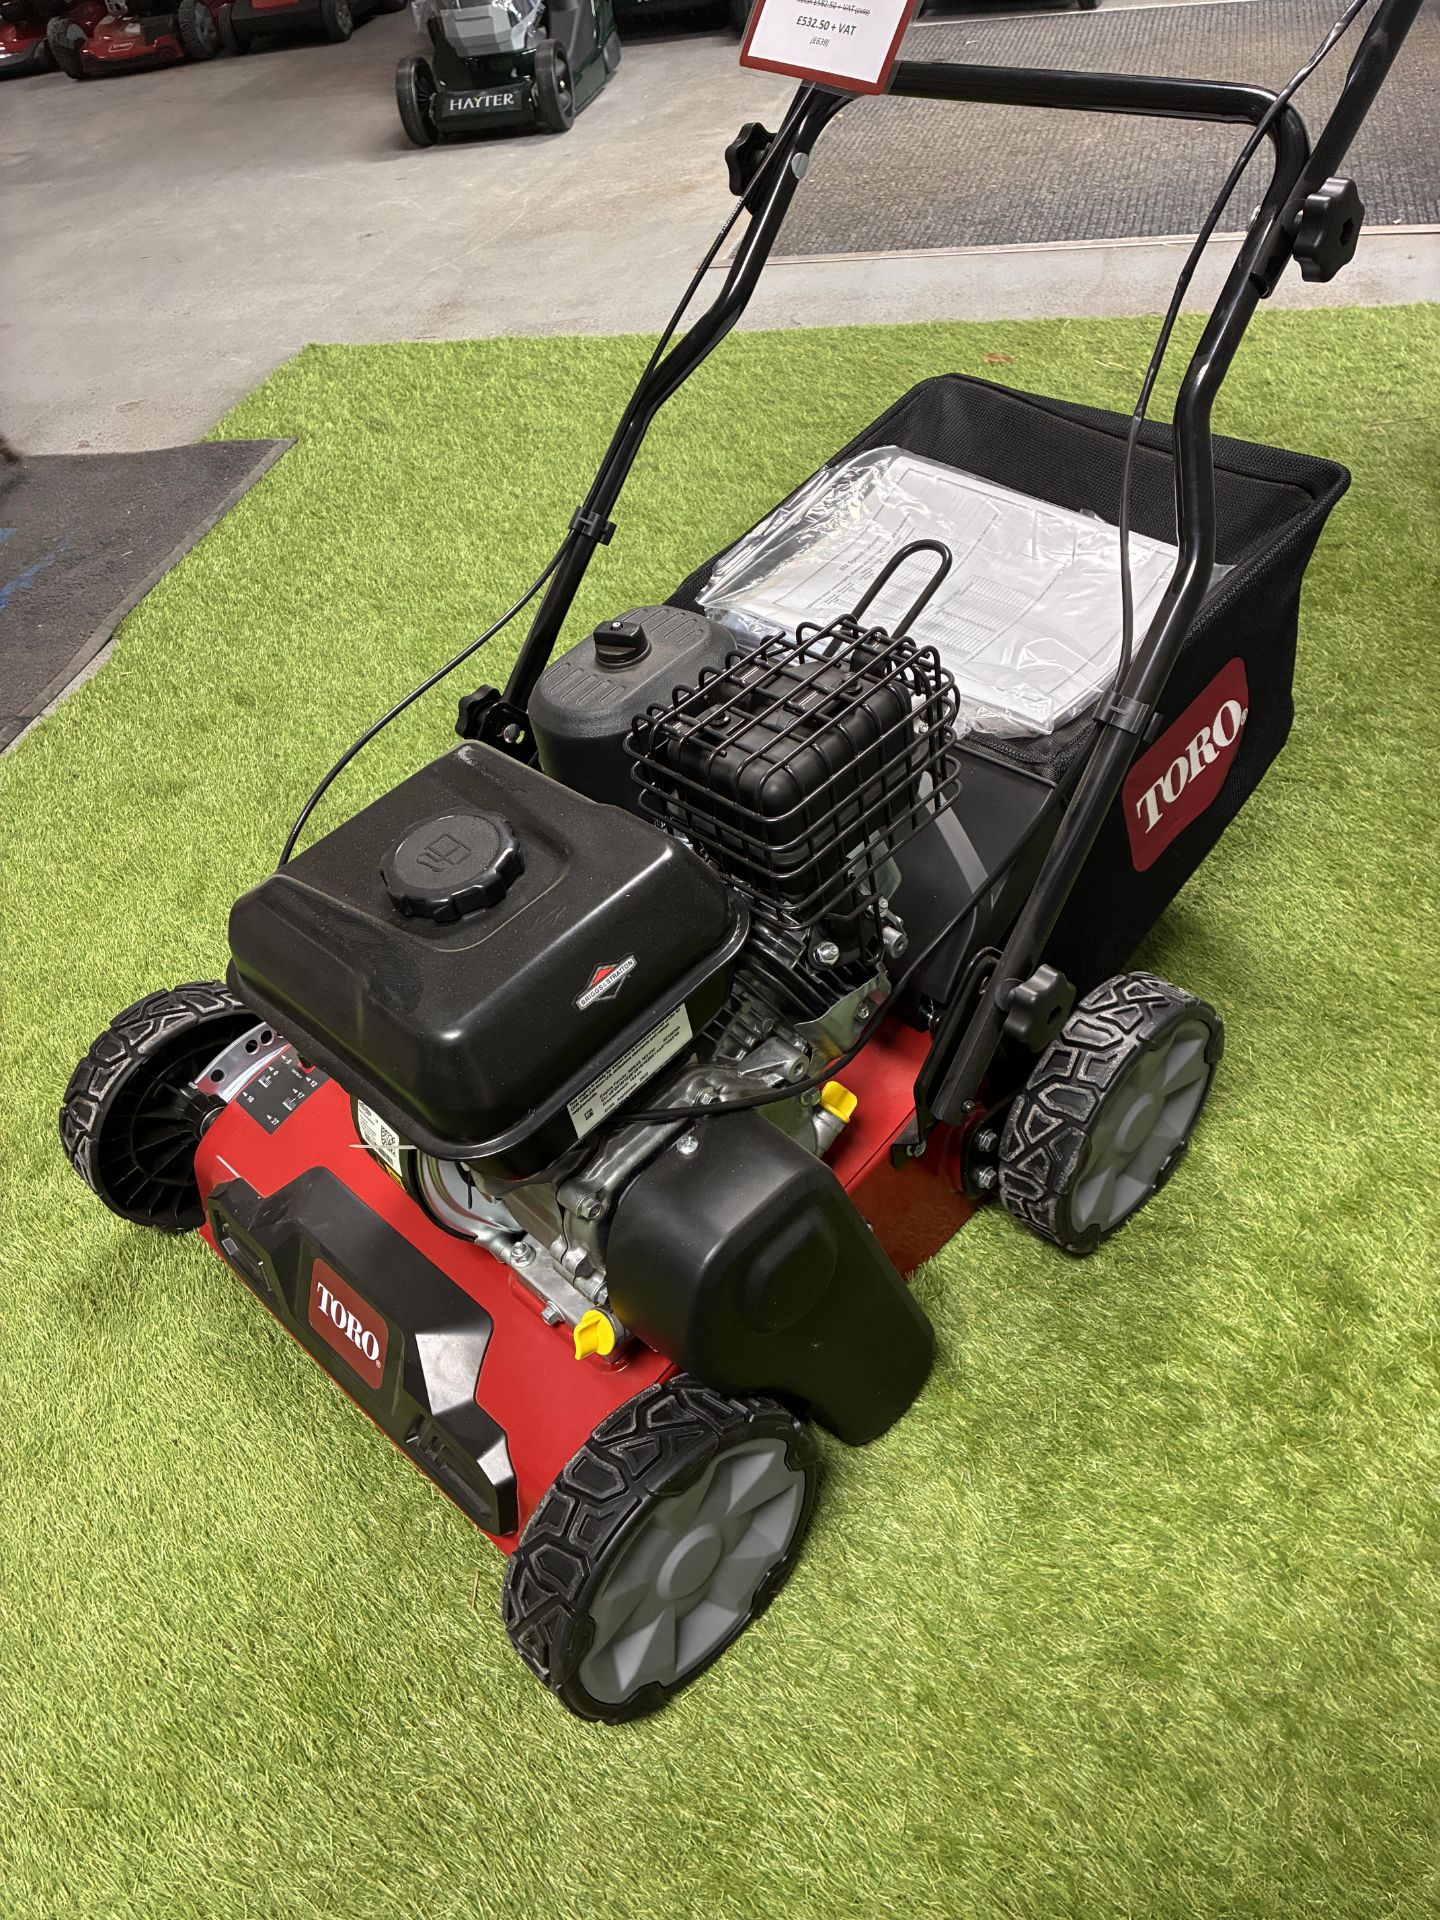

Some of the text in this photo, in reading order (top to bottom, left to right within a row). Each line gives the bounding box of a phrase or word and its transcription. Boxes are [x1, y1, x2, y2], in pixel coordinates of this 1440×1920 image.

[796, 15, 830, 31] £532.50
[838, 22, 857, 36] VAT
[450, 93, 514, 111] HAYTER
[1136, 699, 1243, 834] TORO
[309, 1080, 318, 1088] 12
[271, 1117, 280, 1126] 27
[317, 1282, 380, 1361] TORO
